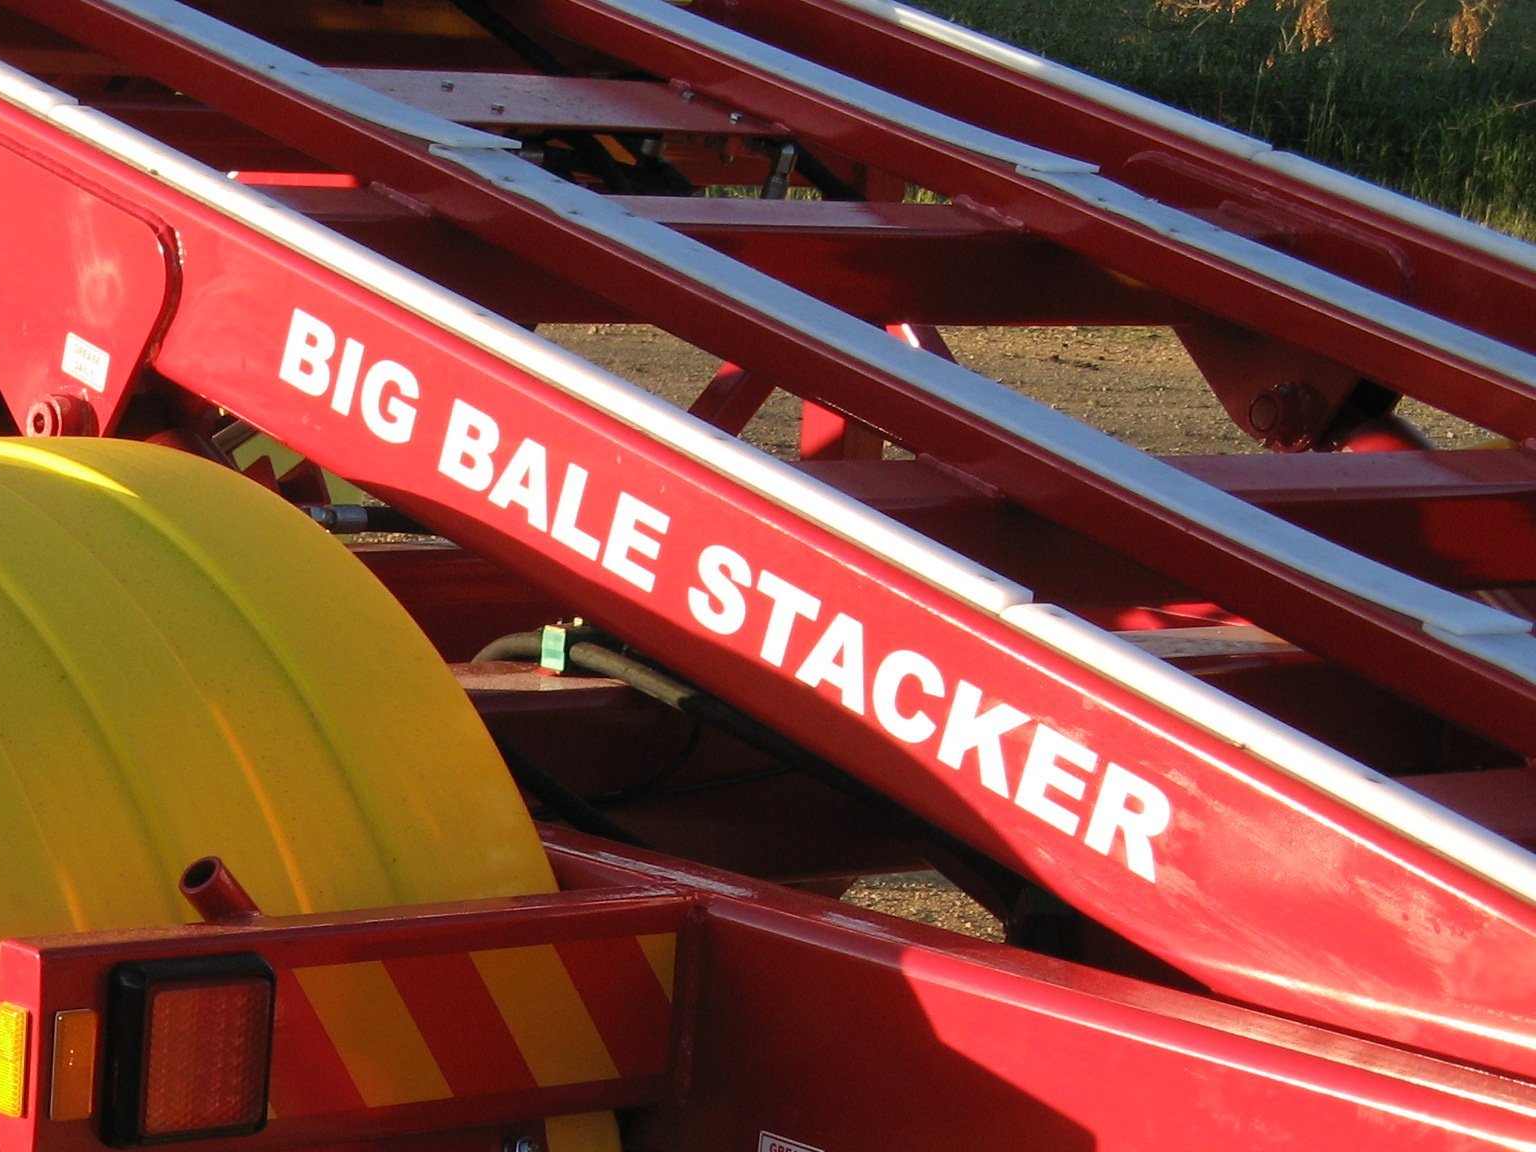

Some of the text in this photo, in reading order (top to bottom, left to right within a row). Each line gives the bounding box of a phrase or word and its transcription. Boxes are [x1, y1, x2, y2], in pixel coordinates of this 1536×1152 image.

[278, 307, 1174, 884] BIG BALE STACKER
